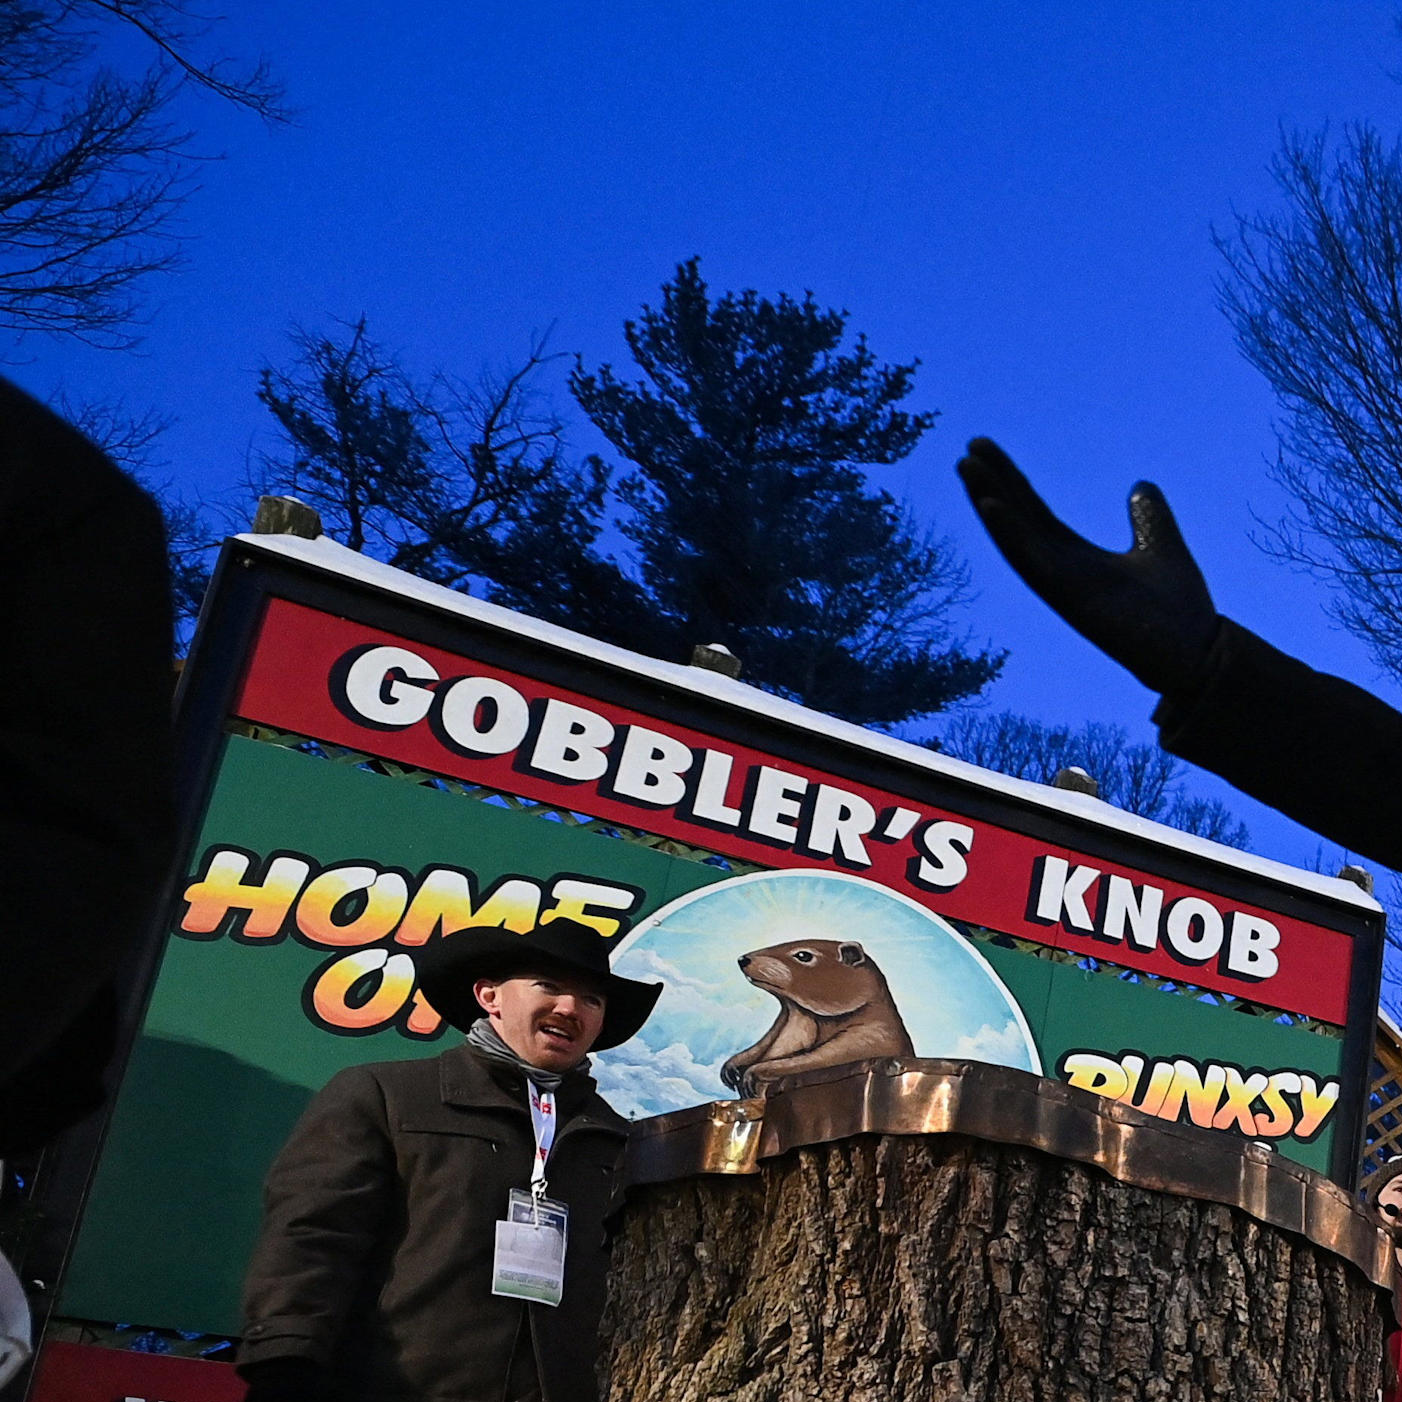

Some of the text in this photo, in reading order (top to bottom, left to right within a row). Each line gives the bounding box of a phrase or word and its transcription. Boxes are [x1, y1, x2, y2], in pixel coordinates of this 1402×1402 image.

[345, 645, 1281, 981] GOBBLER'S KNOB
[312, 948, 443, 1035] O
[1063, 1052, 1341, 1138] PUNXSY
